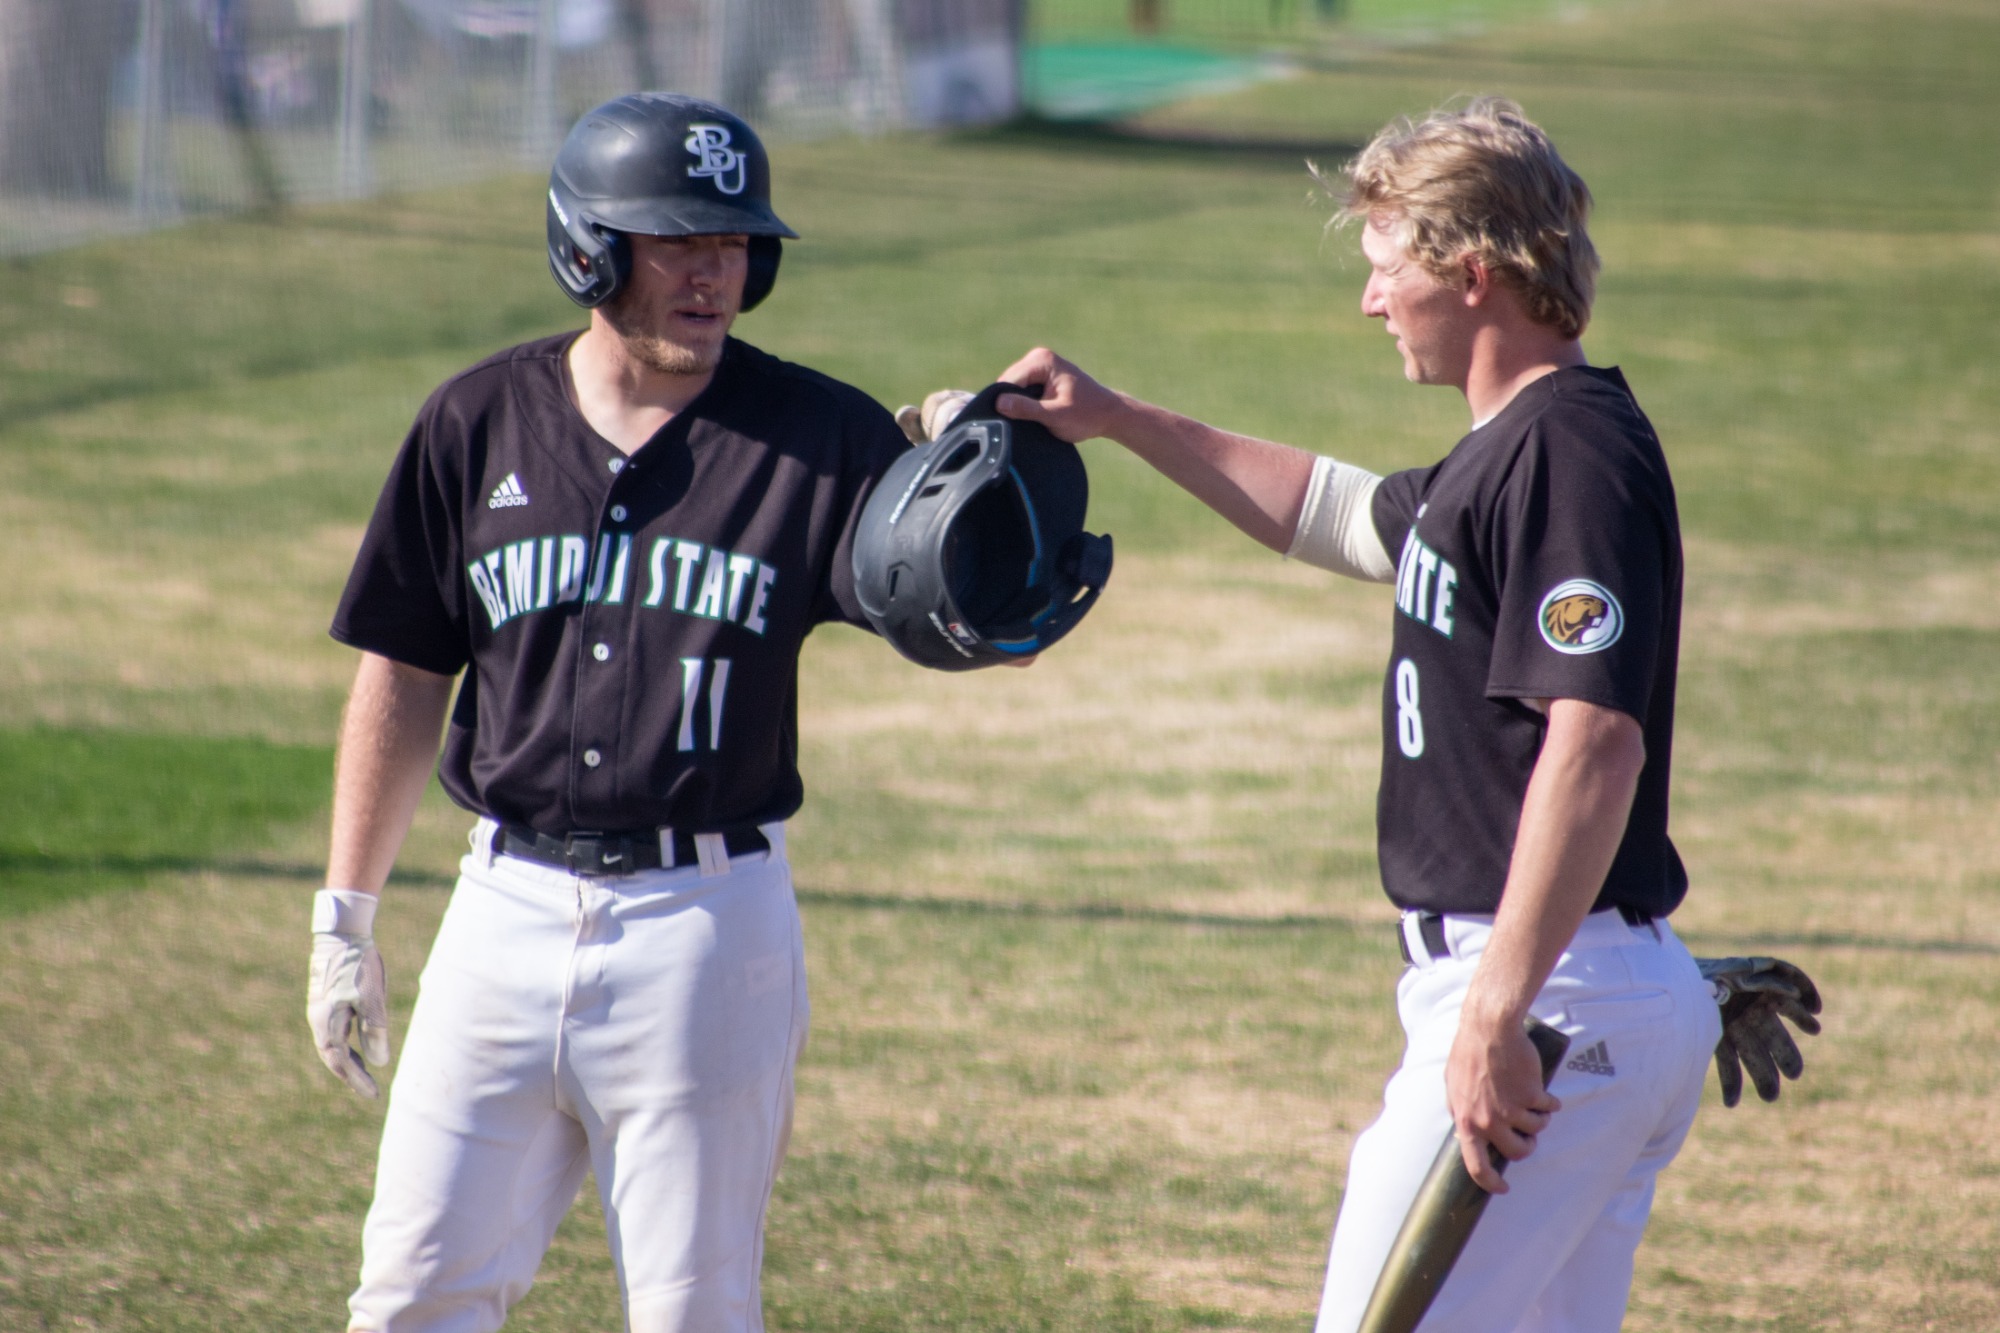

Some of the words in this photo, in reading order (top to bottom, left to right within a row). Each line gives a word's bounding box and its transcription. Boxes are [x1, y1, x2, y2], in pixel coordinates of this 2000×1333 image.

[488, 494, 529, 510] adidas
[467, 532, 634, 633] BEMIDJI
[641, 535, 778, 637] STATE
[676, 656, 732, 752] 11
[1395, 657, 1425, 761] 8
[1566, 1059, 1616, 1078] adidas
